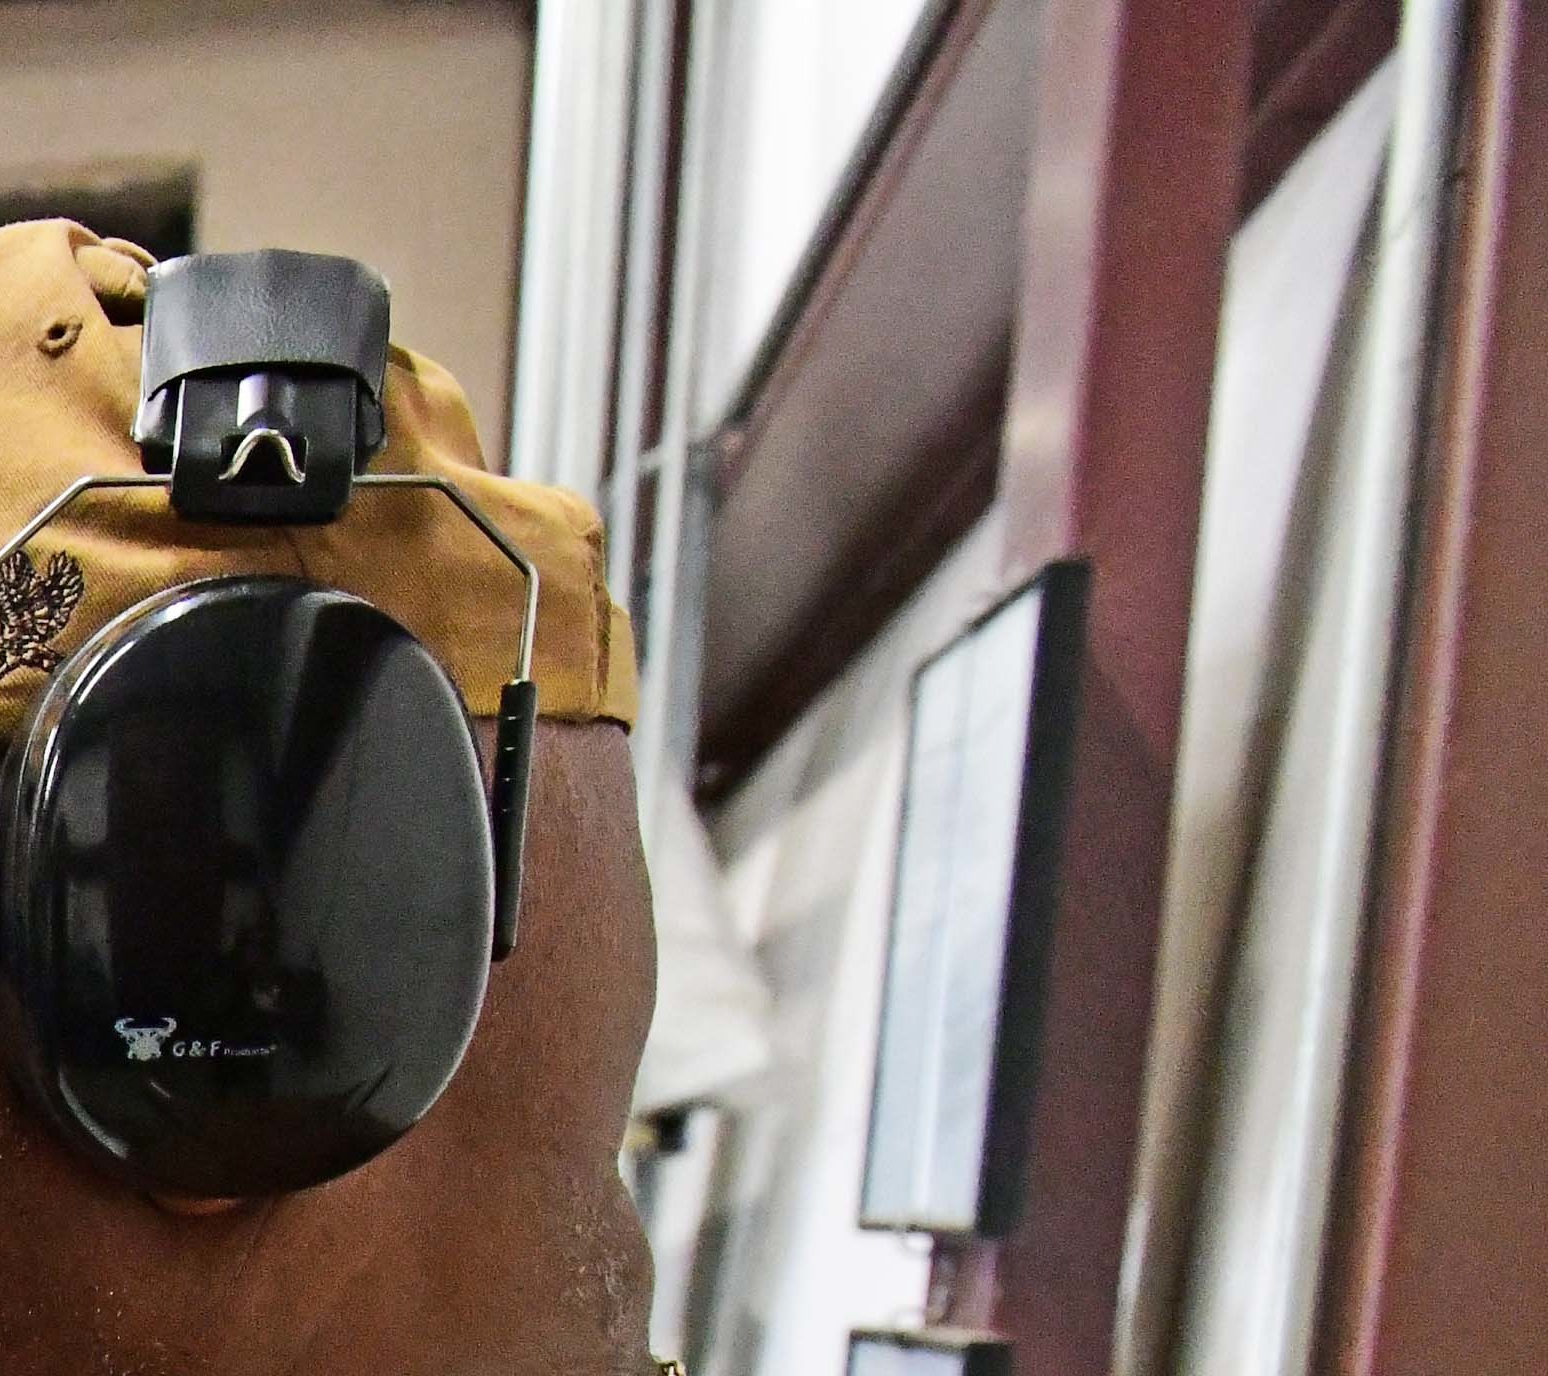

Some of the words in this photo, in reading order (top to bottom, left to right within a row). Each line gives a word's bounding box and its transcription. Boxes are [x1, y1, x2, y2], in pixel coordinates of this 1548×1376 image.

[172, 1041, 185, 1057] G
[189, 1040, 206, 1057] &
[210, 1040, 222, 1057] F
